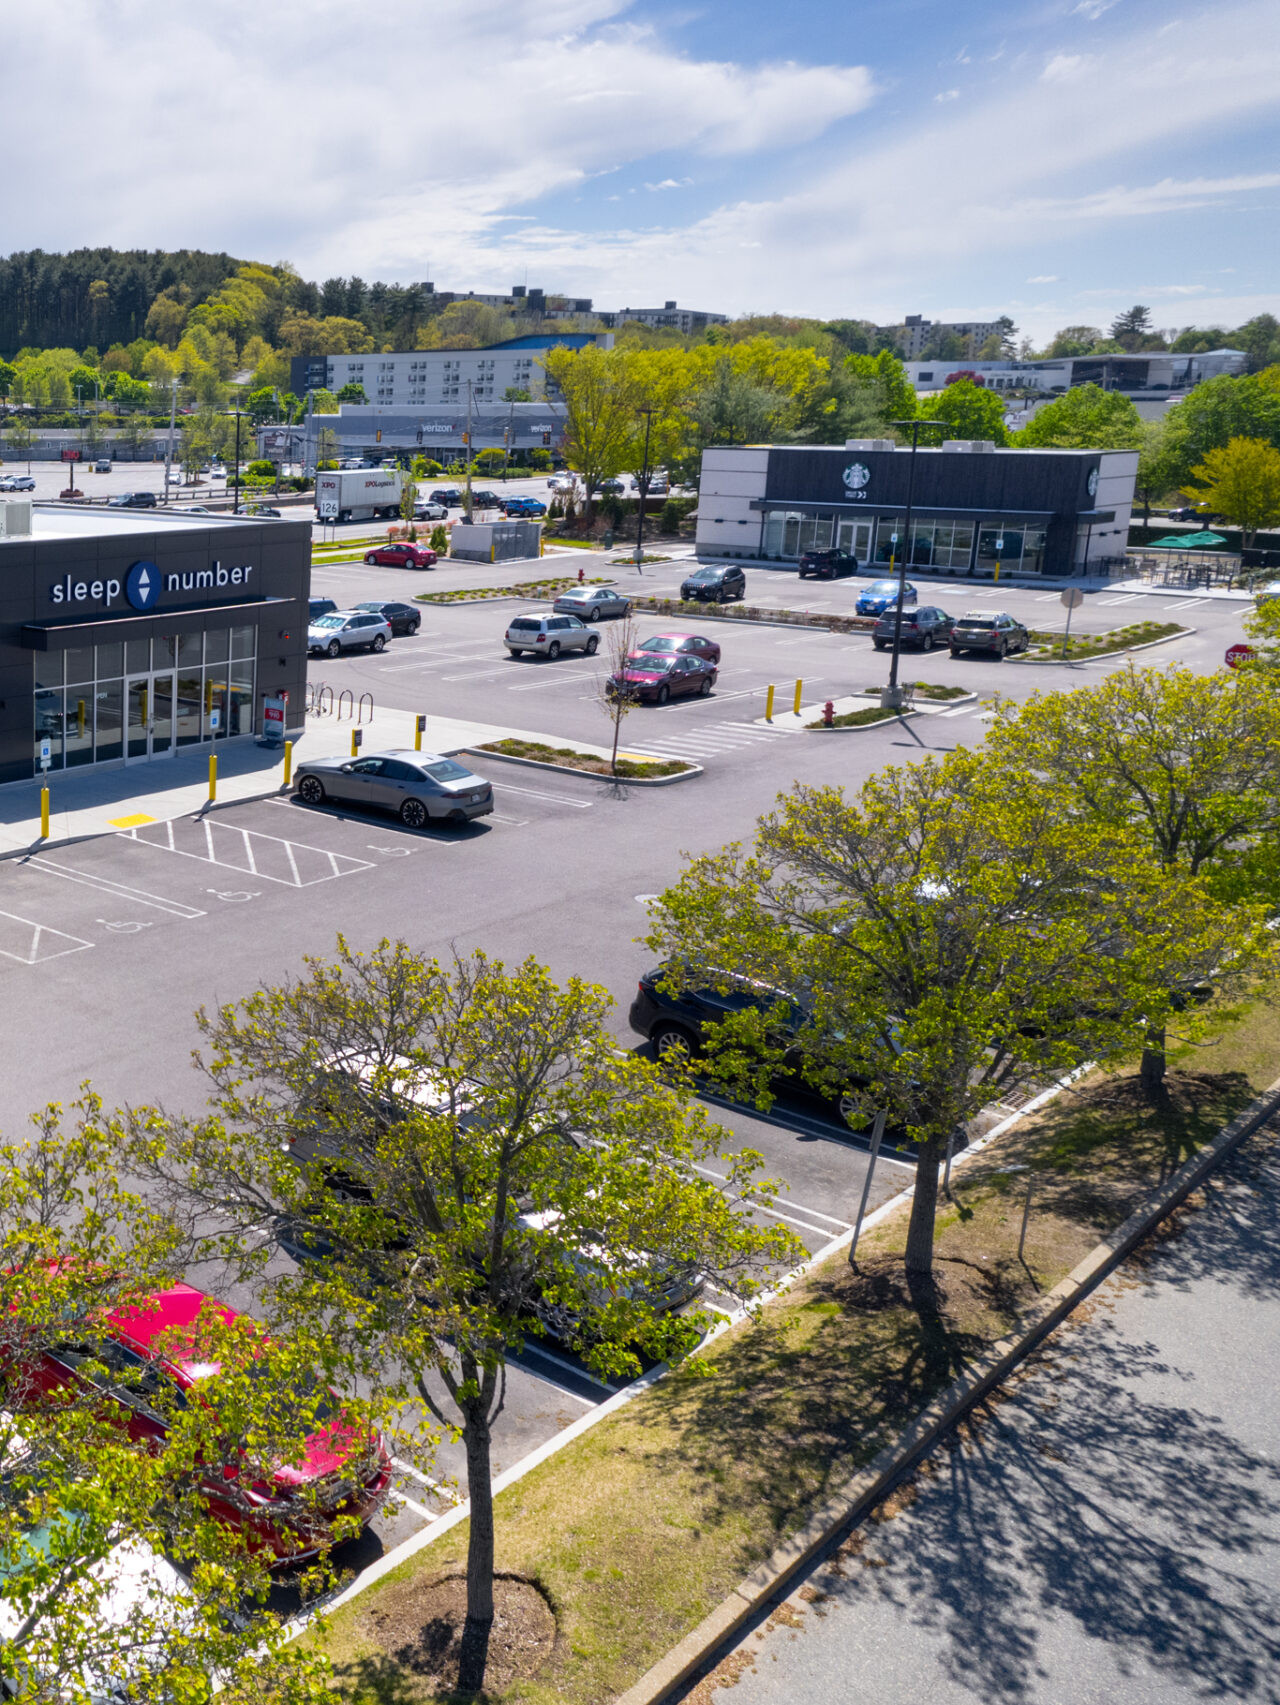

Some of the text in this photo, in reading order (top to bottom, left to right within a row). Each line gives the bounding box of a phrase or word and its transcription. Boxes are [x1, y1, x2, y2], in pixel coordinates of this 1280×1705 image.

[422, 423, 453, 433] verizon
[531, 424, 552, 433] verizon
[321, 481, 336, 489] XPO
[322, 503, 337, 513] 126
[53, 561, 253, 607] sleep number
